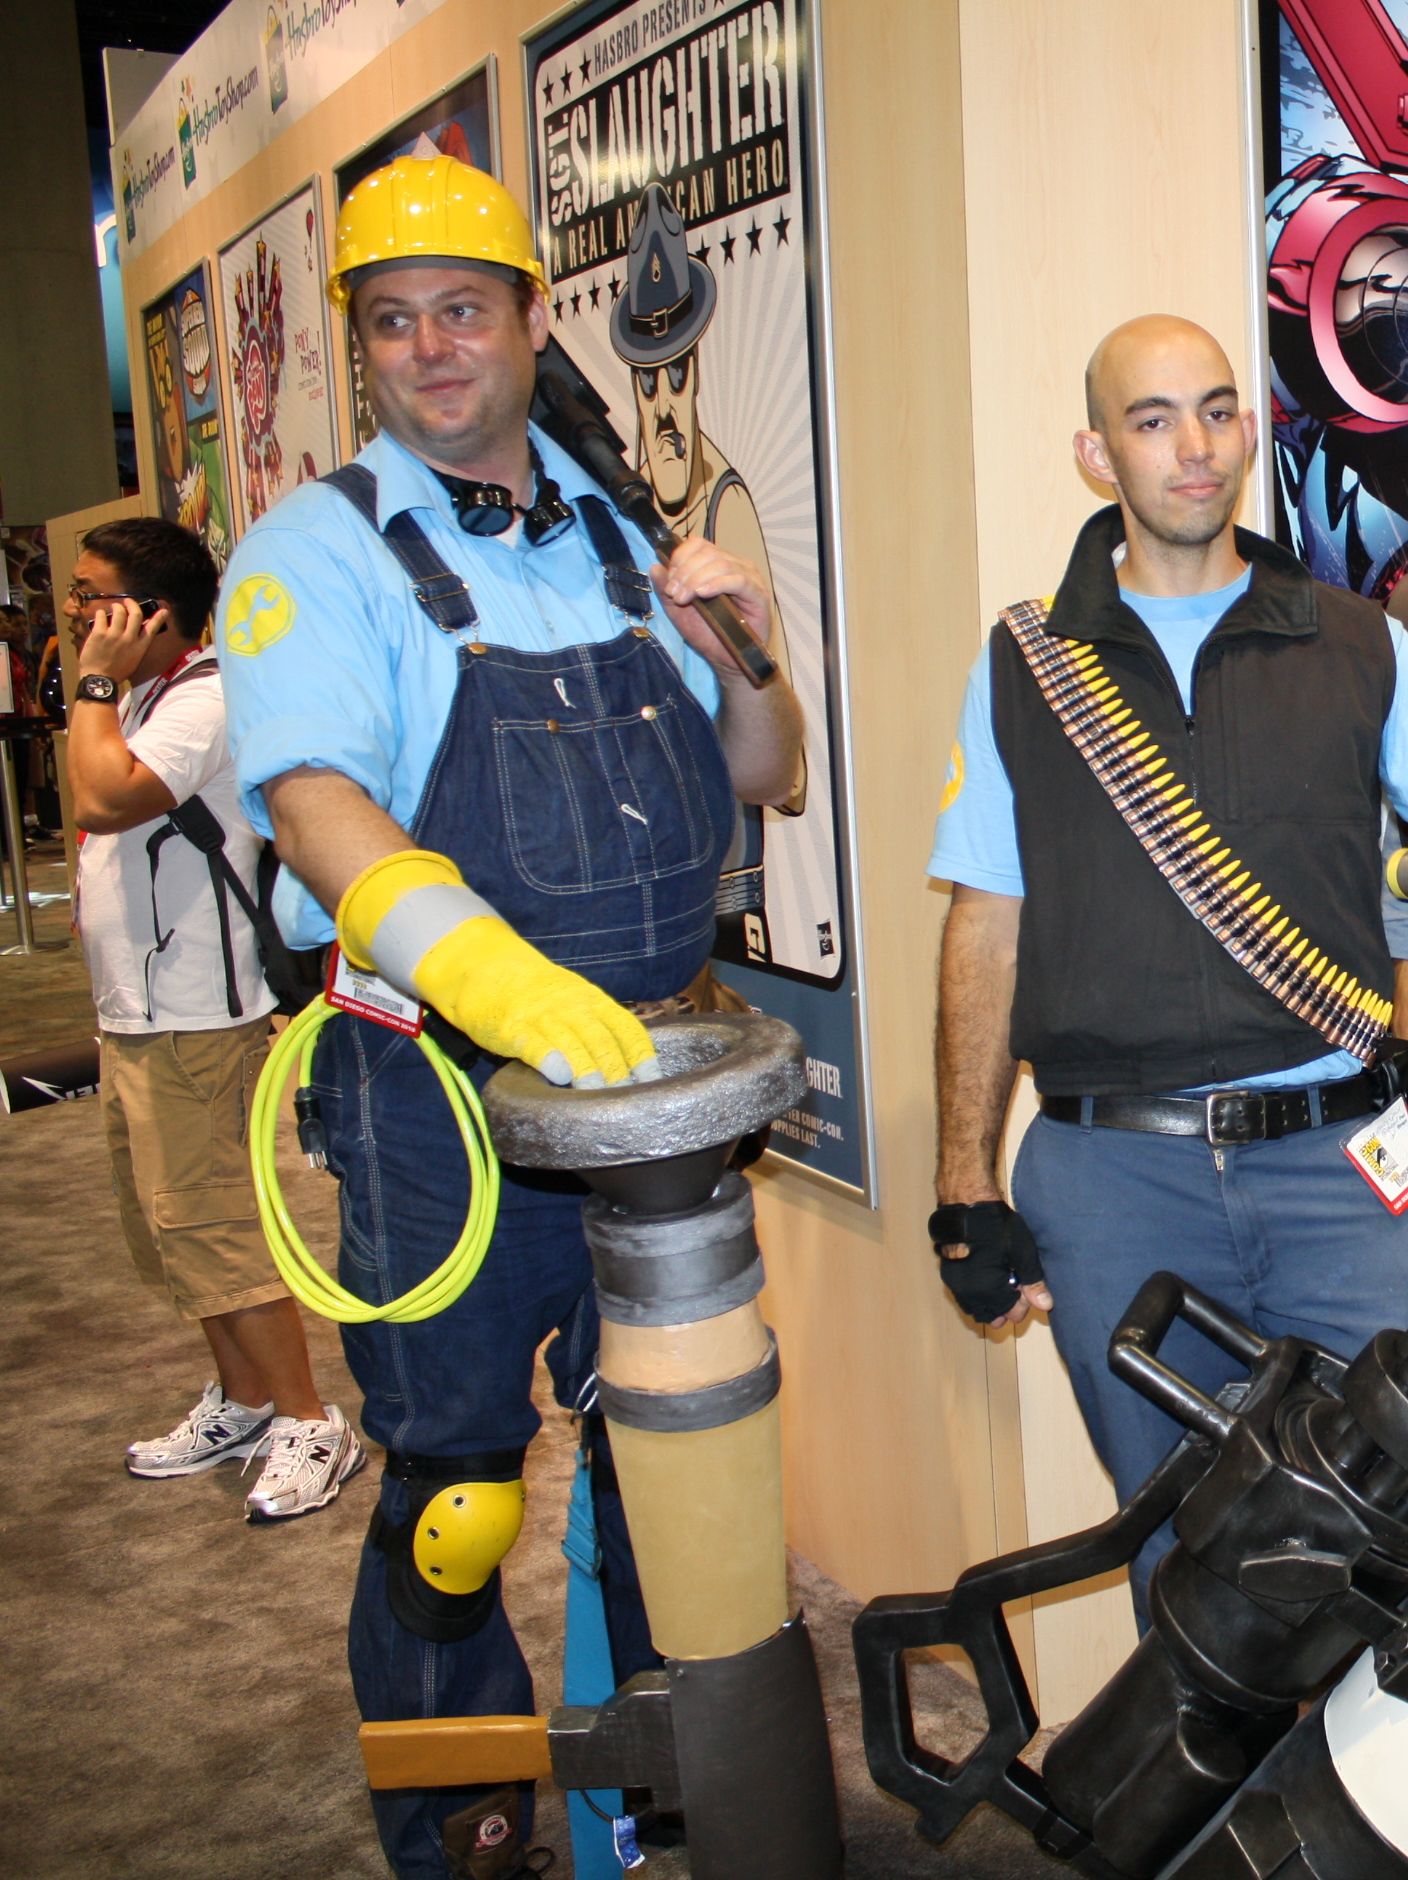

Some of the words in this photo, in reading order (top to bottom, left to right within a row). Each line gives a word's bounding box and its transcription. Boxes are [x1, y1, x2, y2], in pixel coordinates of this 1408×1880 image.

[594, 26, 639, 76] HASBRO
[570, 1, 785, 216] SLAUGHTER
[553, 236, 562, 276] A
[568, 216, 608, 269] REAL
[806, 1056, 843, 1098] GHTER
